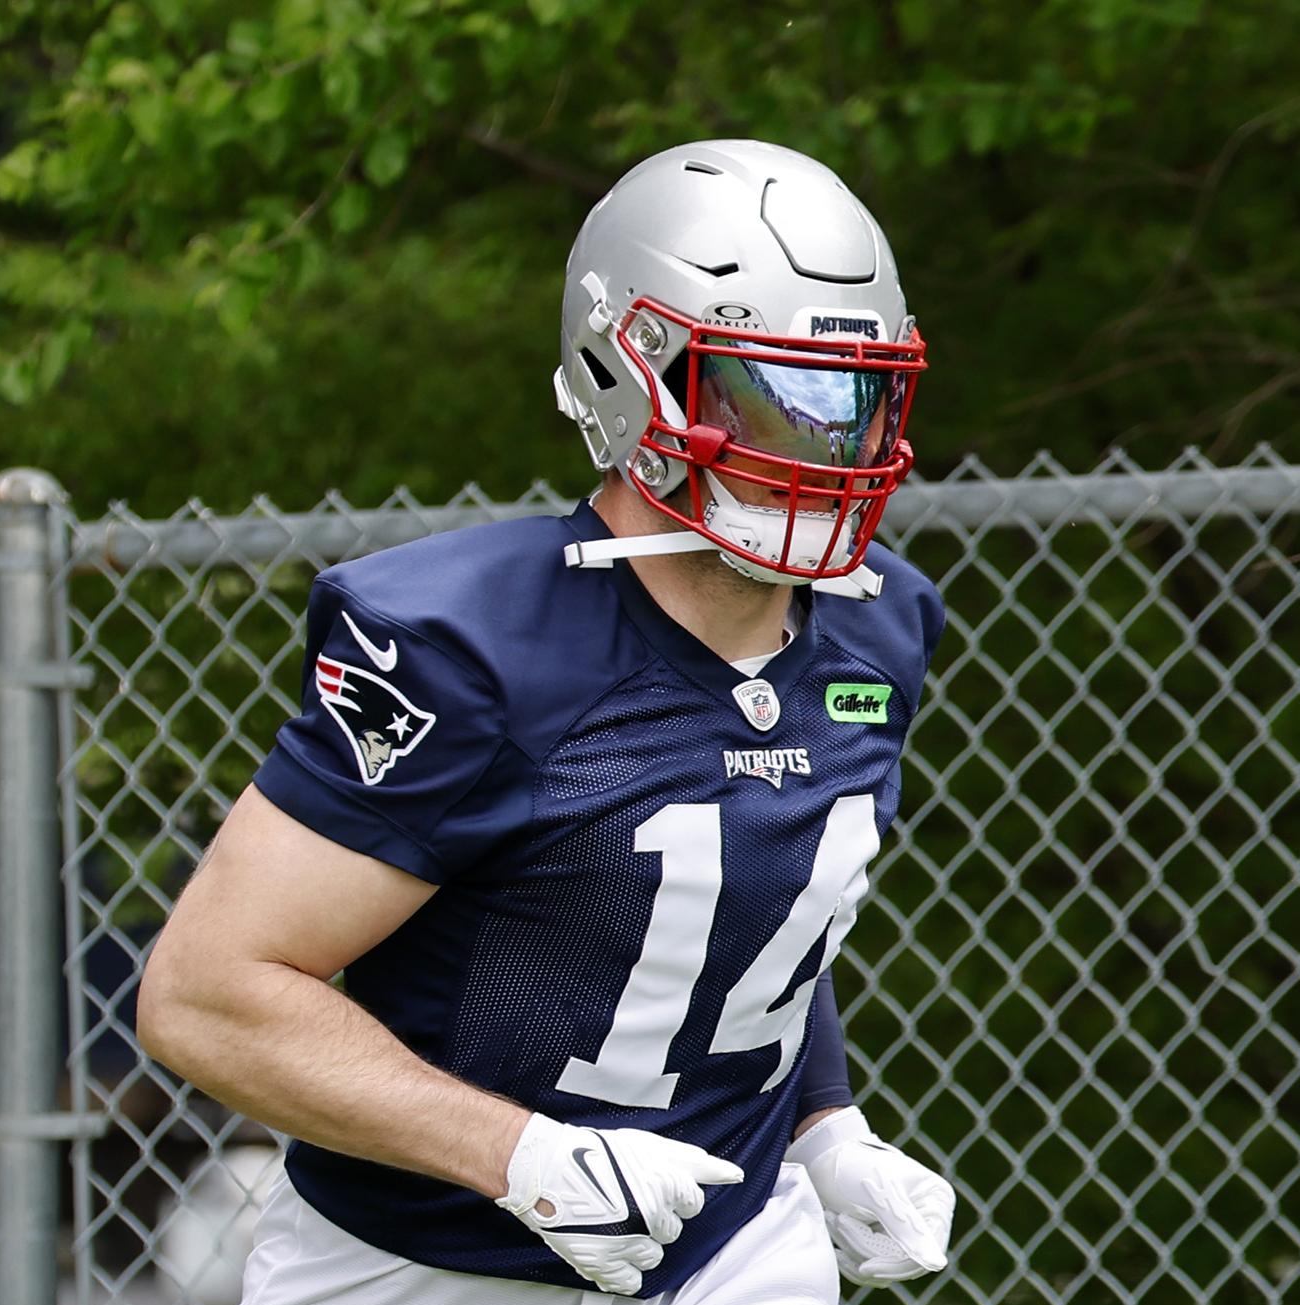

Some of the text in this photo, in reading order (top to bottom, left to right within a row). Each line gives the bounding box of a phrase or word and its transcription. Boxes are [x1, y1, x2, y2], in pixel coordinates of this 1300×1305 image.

[705, 319, 760, 329] OAKLEY
[811, 316, 879, 340] PATRIOTS
[756, 704, 773, 719] NFL
[833, 694, 882, 714] Gillette
[723, 748, 812, 779] PATRIOTS
[555, 794, 880, 1110] 14
